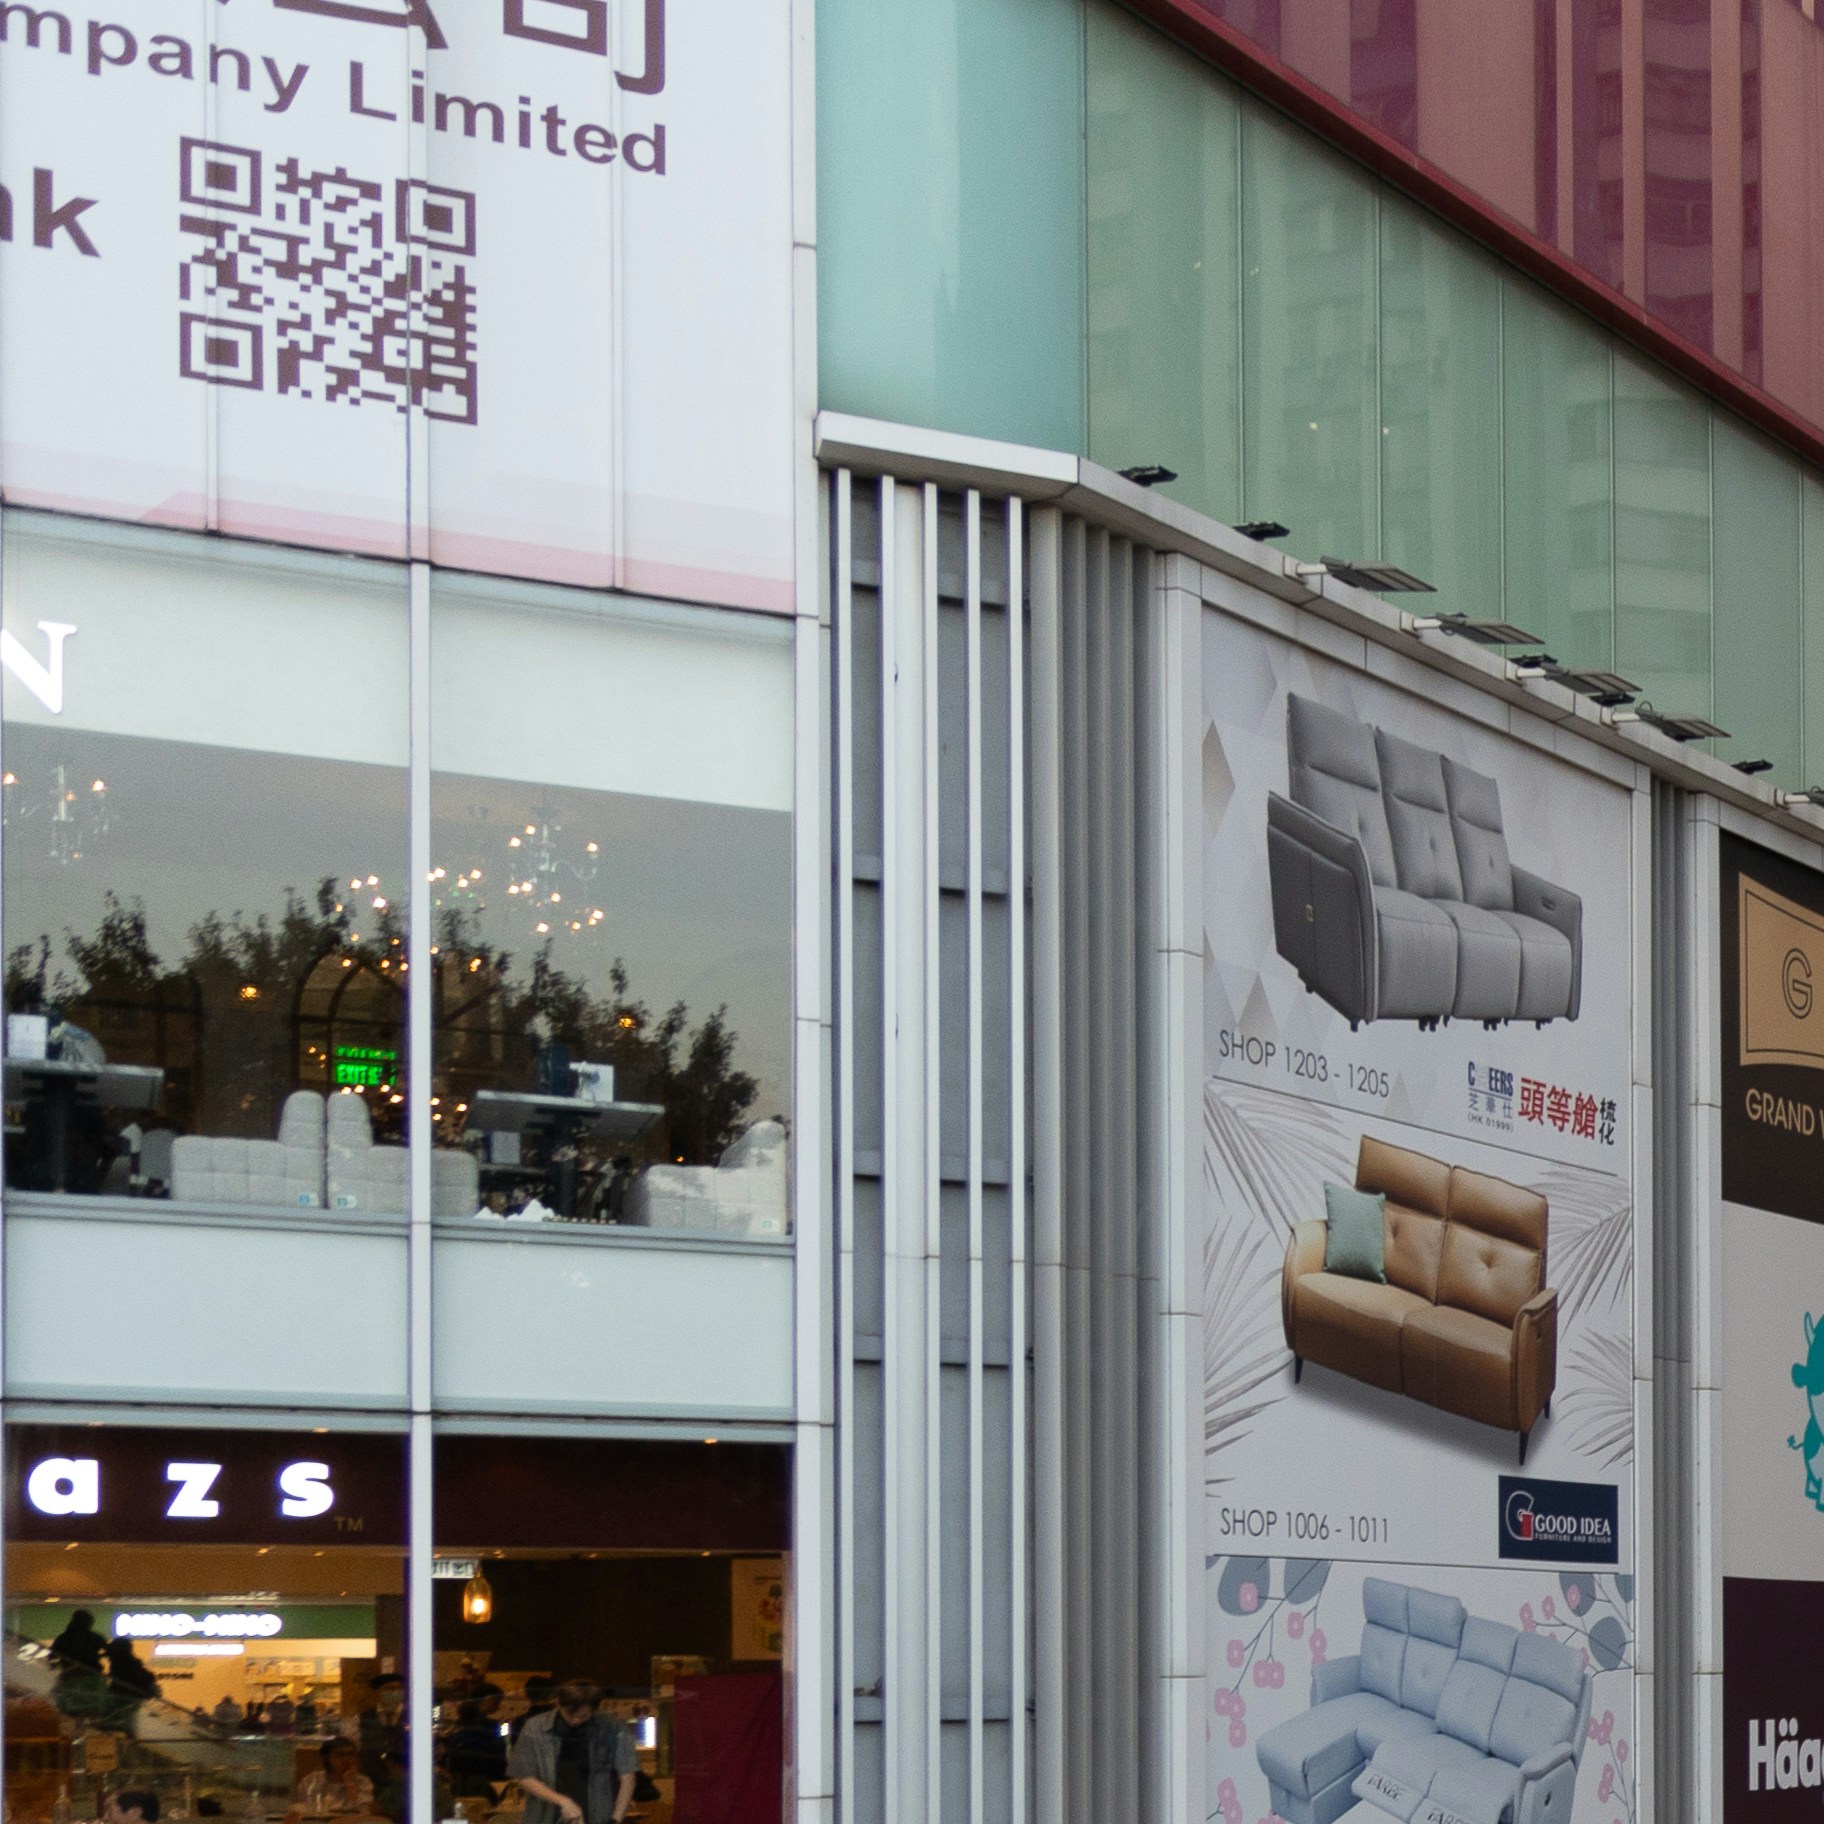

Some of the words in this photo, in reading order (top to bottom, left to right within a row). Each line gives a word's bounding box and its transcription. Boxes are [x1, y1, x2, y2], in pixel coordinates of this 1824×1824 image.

[349, 60, 667, 176] Limited
[1219, 1030, 1276, 1068] SHOP
[1285, 1047, 1328, 1080] 1203
[1347, 1064, 1390, 1098] 1205
[1518, 1077, 1599, 1140] 頭等艙
[1745, 1087, 1816, 1135] GRAND
[1220, 1507, 1277, 1538] SHOP
[1286, 1514, 1329, 1542] 1006
[1348, 1516, 1388, 1543] 1011
[1534, 1515, 1577, 1535] GOOD
[1580, 1518, 1612, 1538] IDEA
